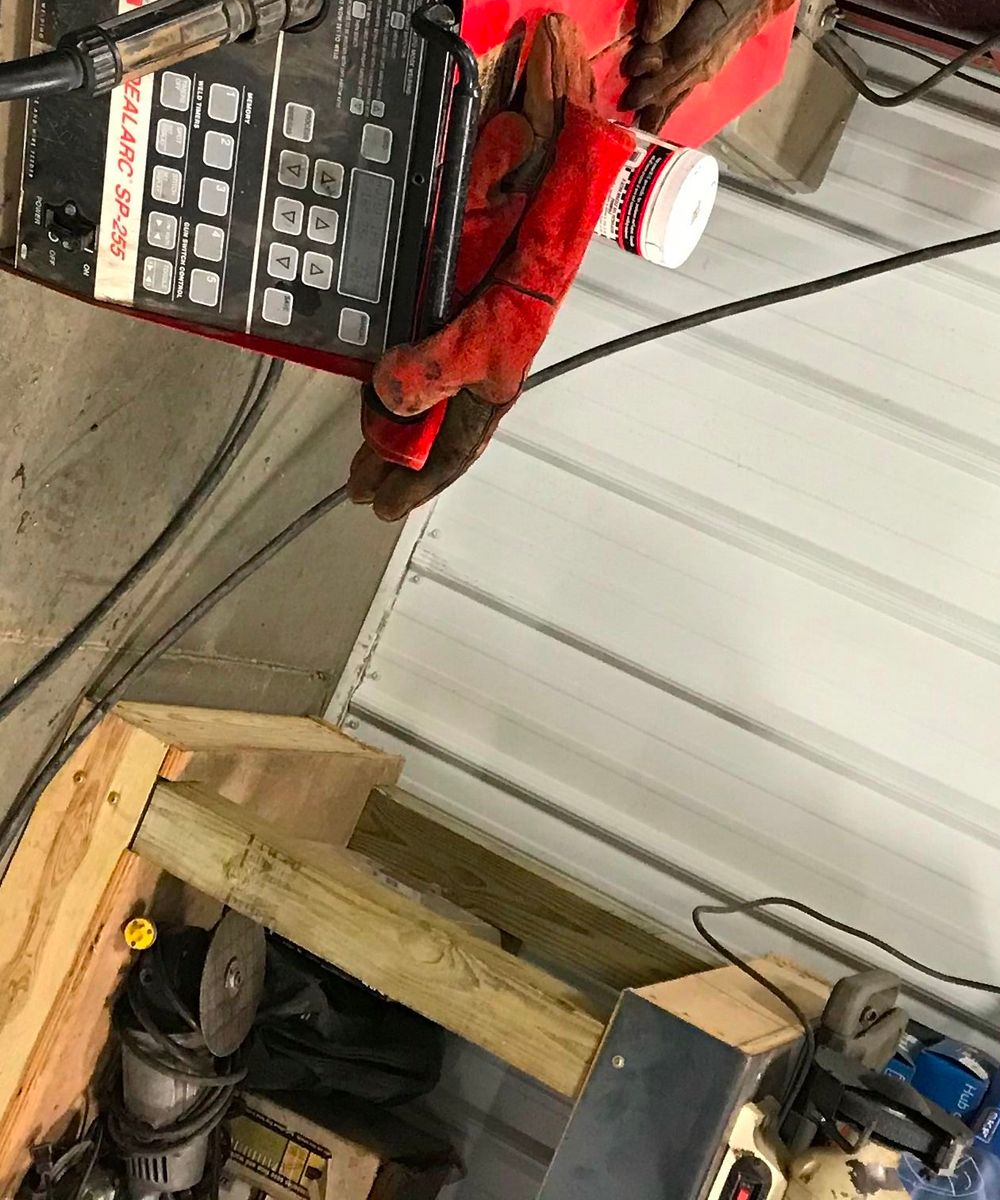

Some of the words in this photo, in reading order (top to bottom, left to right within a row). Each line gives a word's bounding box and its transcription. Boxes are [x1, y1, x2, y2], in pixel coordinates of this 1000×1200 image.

[193, 102, 201, 128] TIMERS
[244, 92, 252, 124] MEMORY
[220, 137, 230, 145] 2
[216, 184, 225, 192] 3
[33, 195, 42, 225] POWER
[109, 184, 131, 260] SP-255
[180, 238, 188, 265] SWITCH
[82, 263, 89, 276] ON
[176, 266, 185, 298] CONTROL
[957, 1083, 976, 1110] Hub
